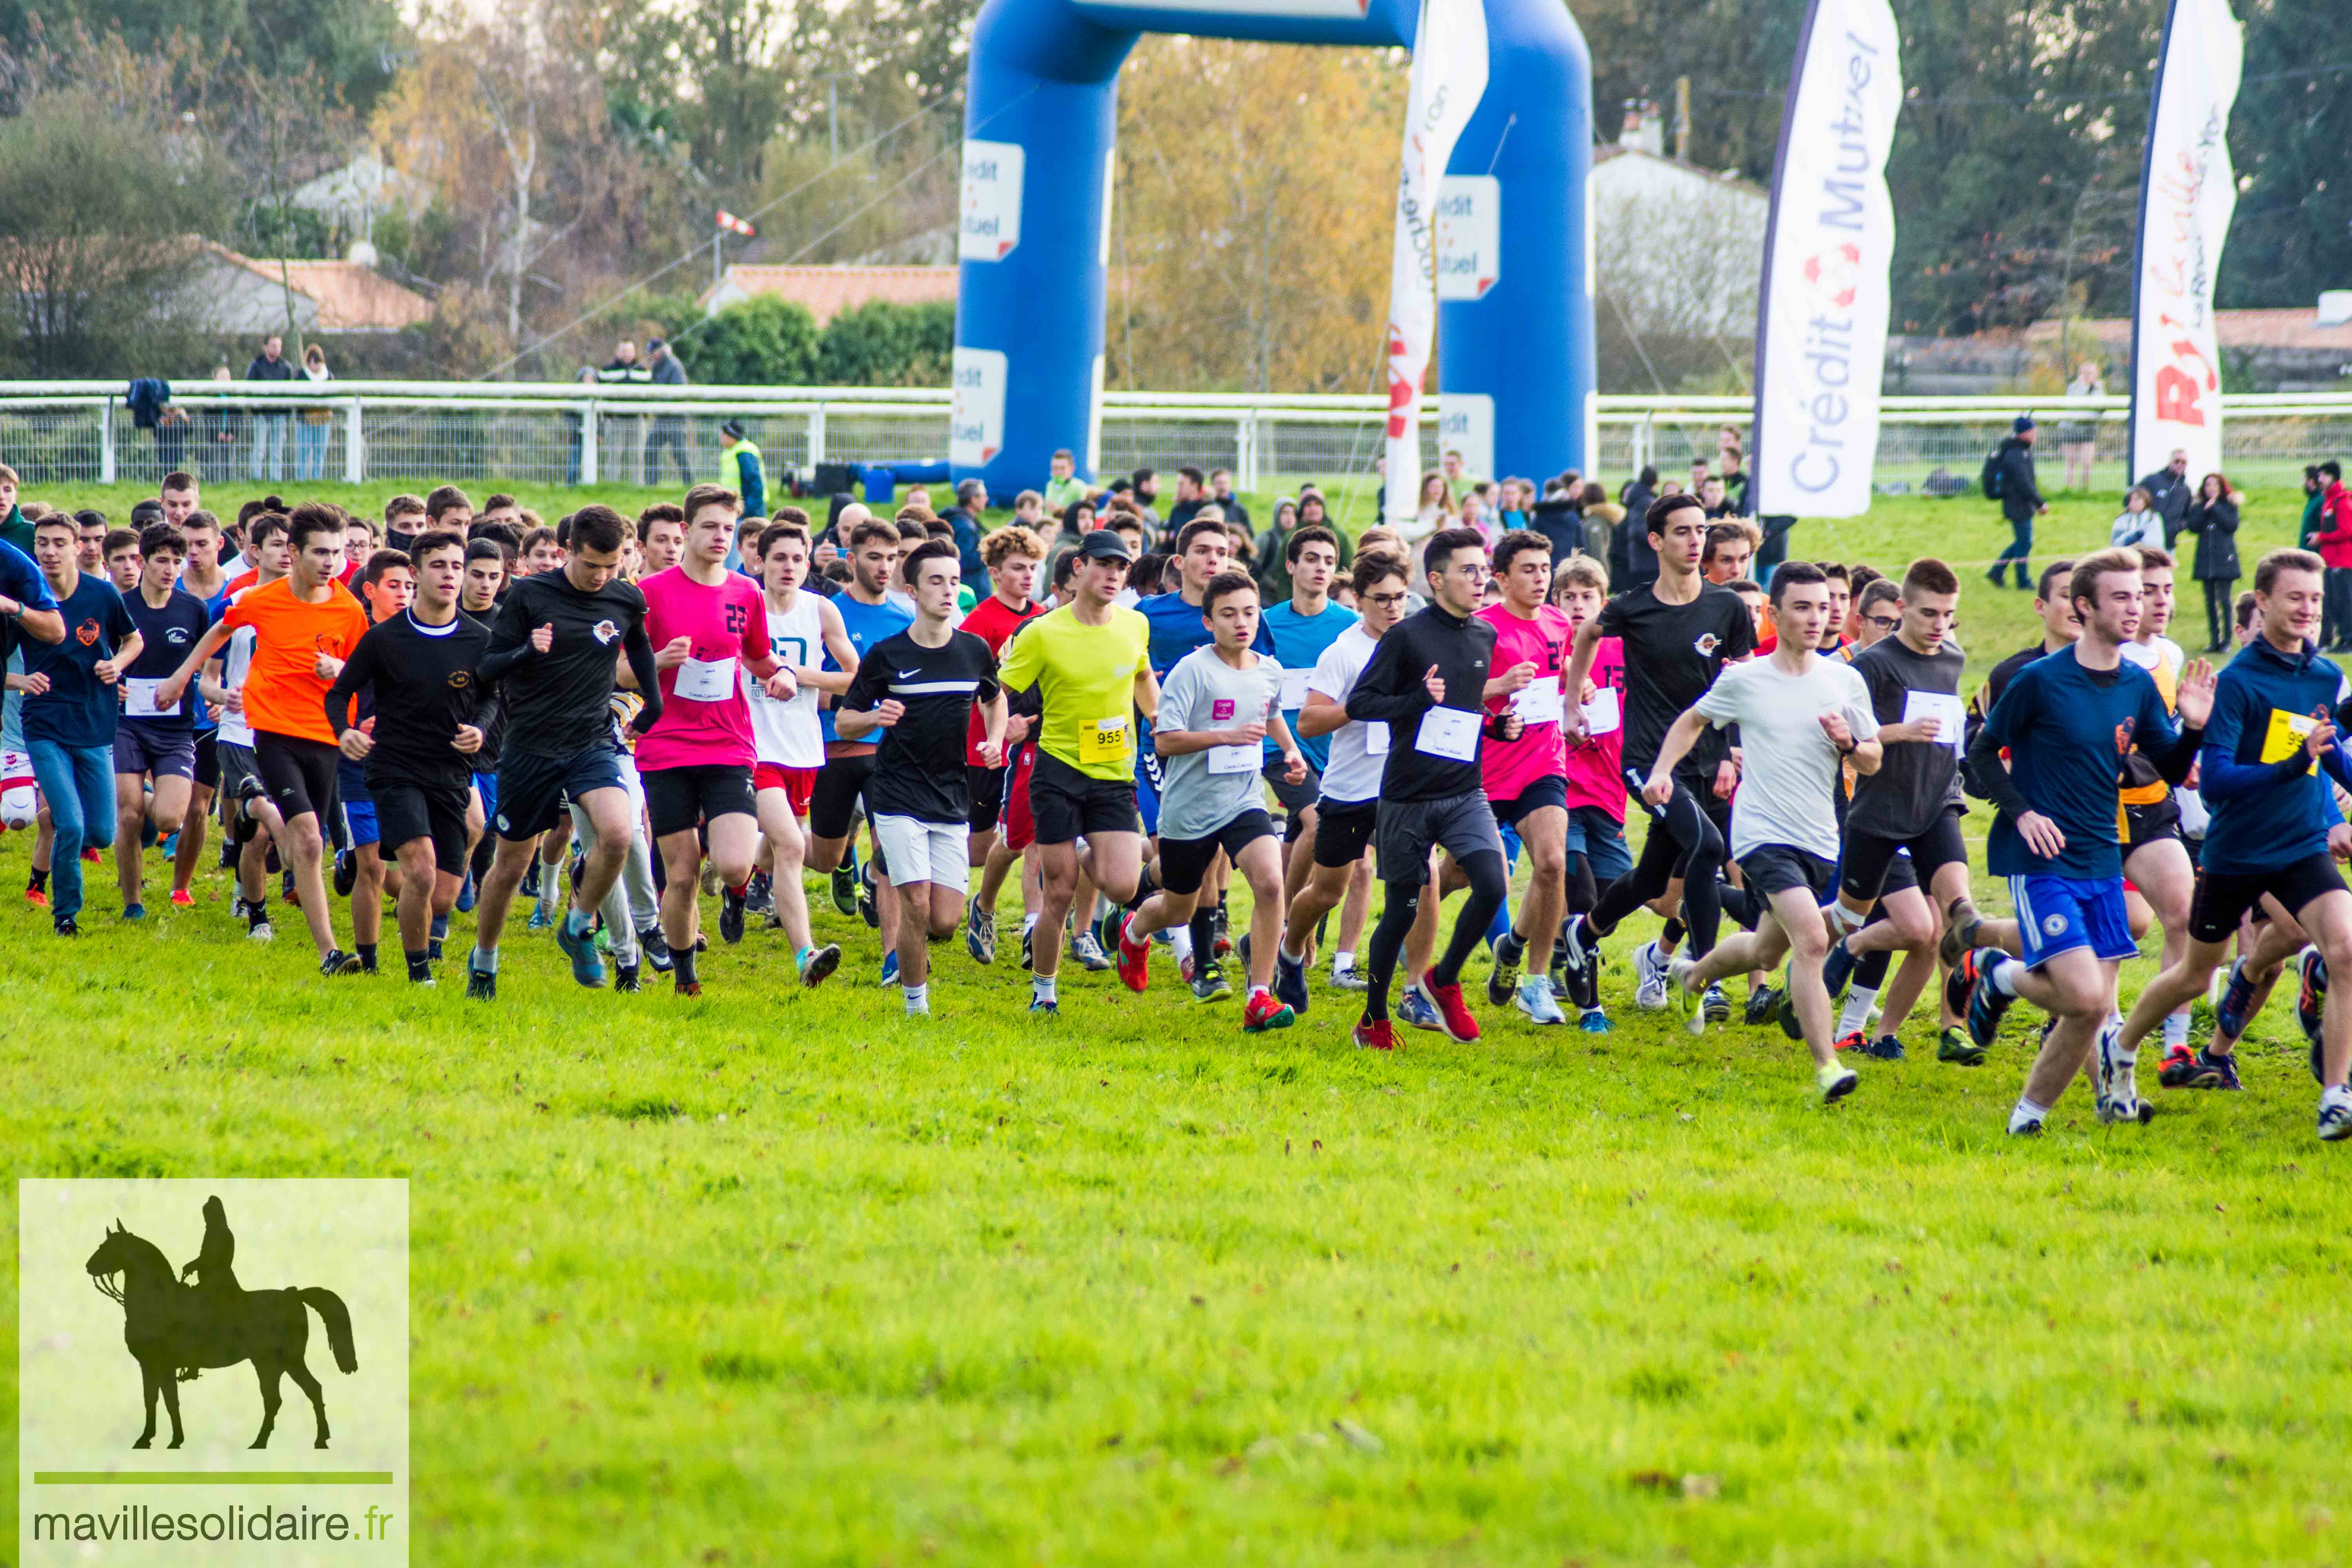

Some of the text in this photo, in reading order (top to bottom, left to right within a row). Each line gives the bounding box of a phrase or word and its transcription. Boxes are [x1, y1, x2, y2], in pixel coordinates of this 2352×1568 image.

[1790, 314, 1853, 493] Crédit
[1547, 641, 1563, 670] 2
[1098, 730, 1121, 744] 955
